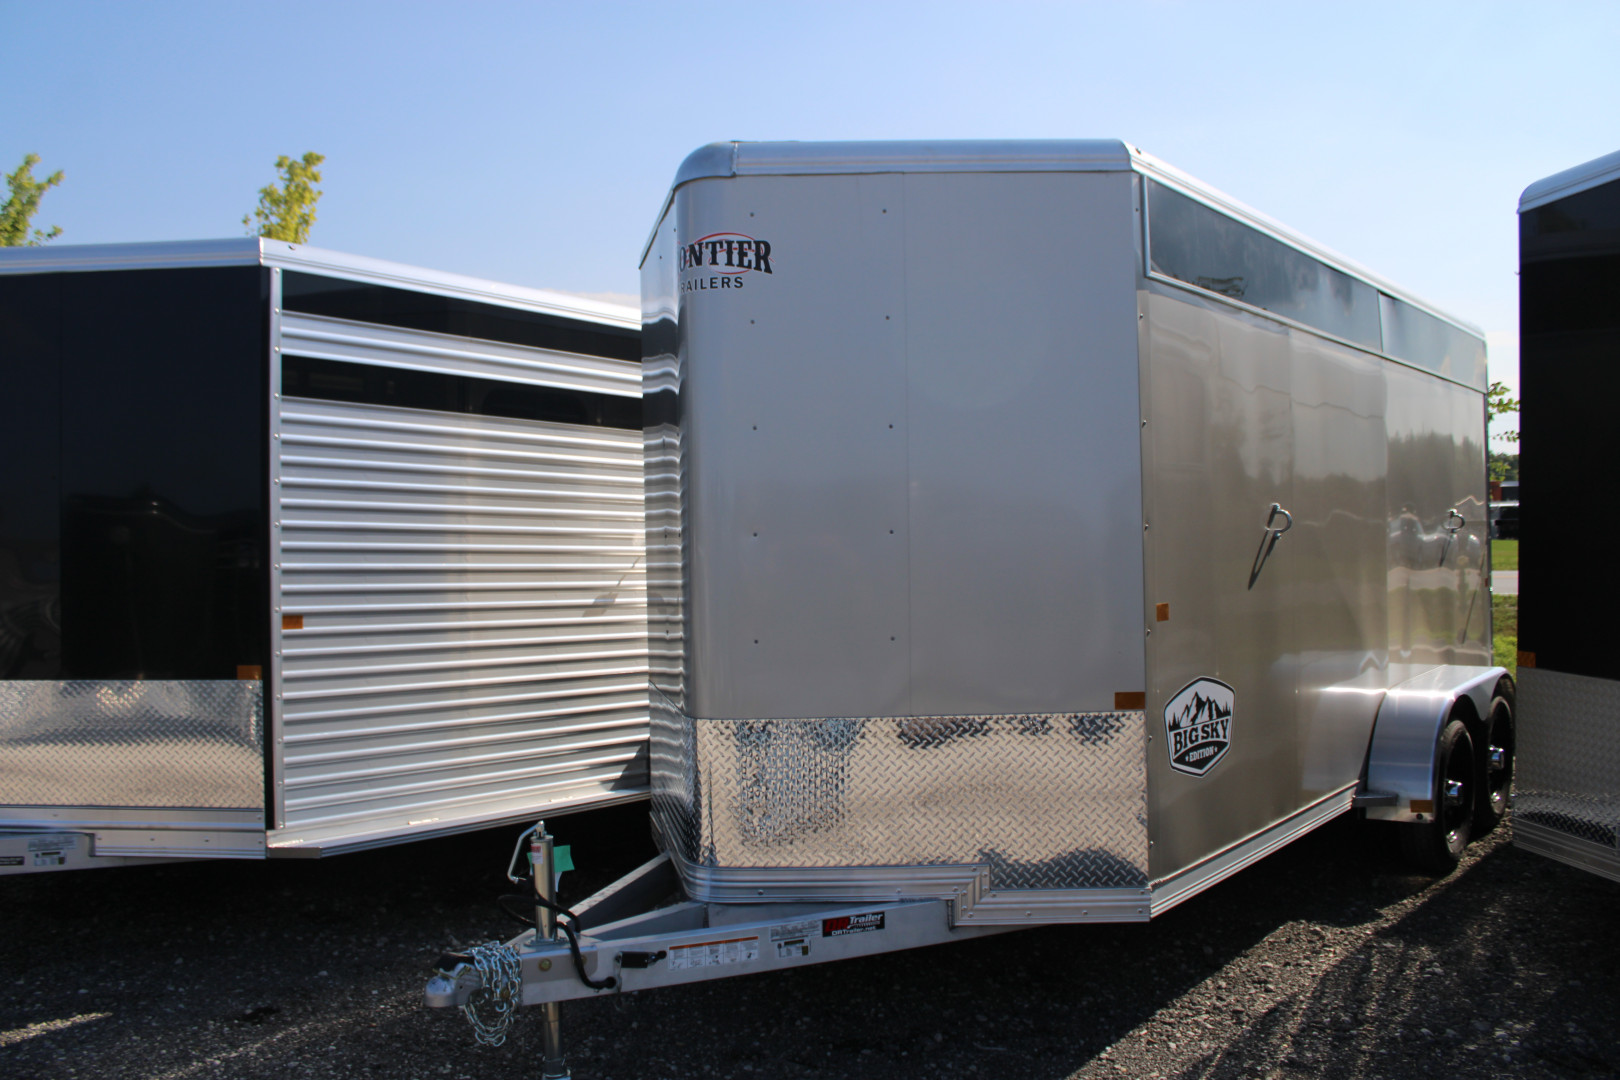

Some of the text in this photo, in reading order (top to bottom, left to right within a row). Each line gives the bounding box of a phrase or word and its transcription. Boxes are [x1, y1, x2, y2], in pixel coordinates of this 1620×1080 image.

[1174, 718, 1229, 756] BIG SKY
[1189, 746, 1214, 762] EDITION
[849, 913, 884, 924] Trailer
